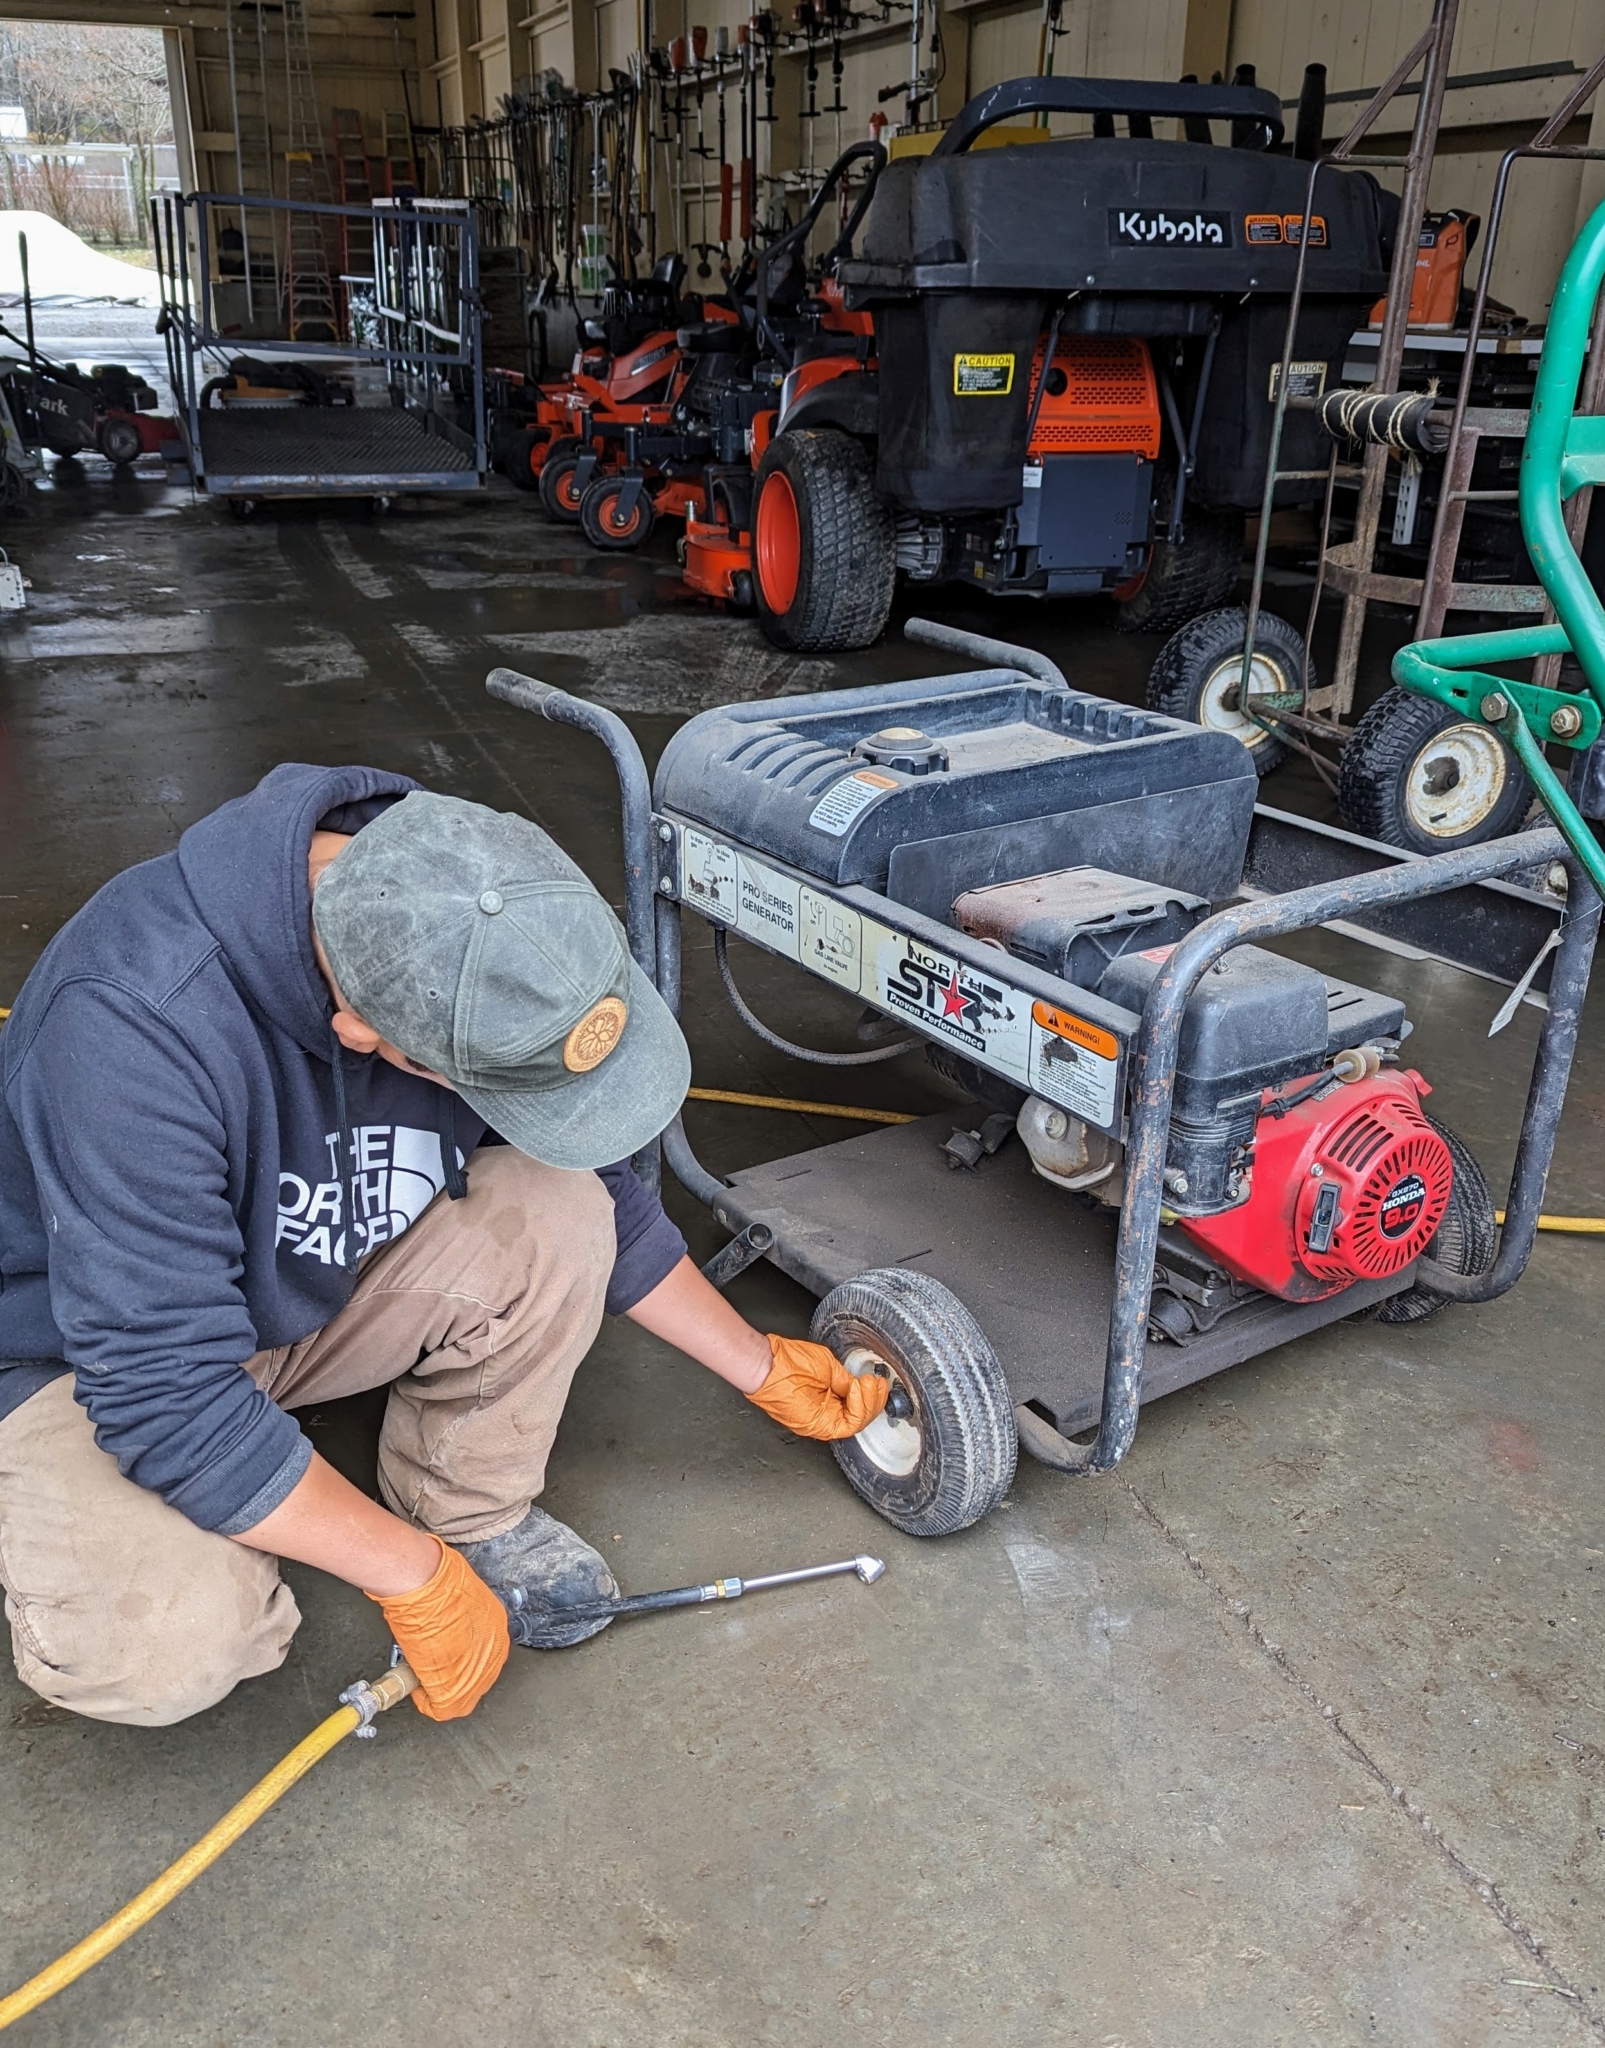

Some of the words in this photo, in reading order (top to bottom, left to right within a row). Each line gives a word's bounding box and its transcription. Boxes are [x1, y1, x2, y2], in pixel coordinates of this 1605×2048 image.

[1119, 212, 1223, 243] Kubota
[968, 356, 1012, 366] CAUTION
[1290, 364, 1324, 373] AUTION
[742, 880, 761, 899] PRO
[761, 890, 794, 917] SERIES
[742, 897, 794, 934] GENERATOR
[889, 992, 921, 1016] Proven
[922, 1010, 984, 1050] Performance
[1063, 1020, 1101, 1045] WARNING!
[325, 1125, 391, 1180] THE
[278, 1168, 389, 1226] ORTH
[1381, 1187, 1426, 1212] HONDA
[1384, 1203, 1420, 1230] 9.0
